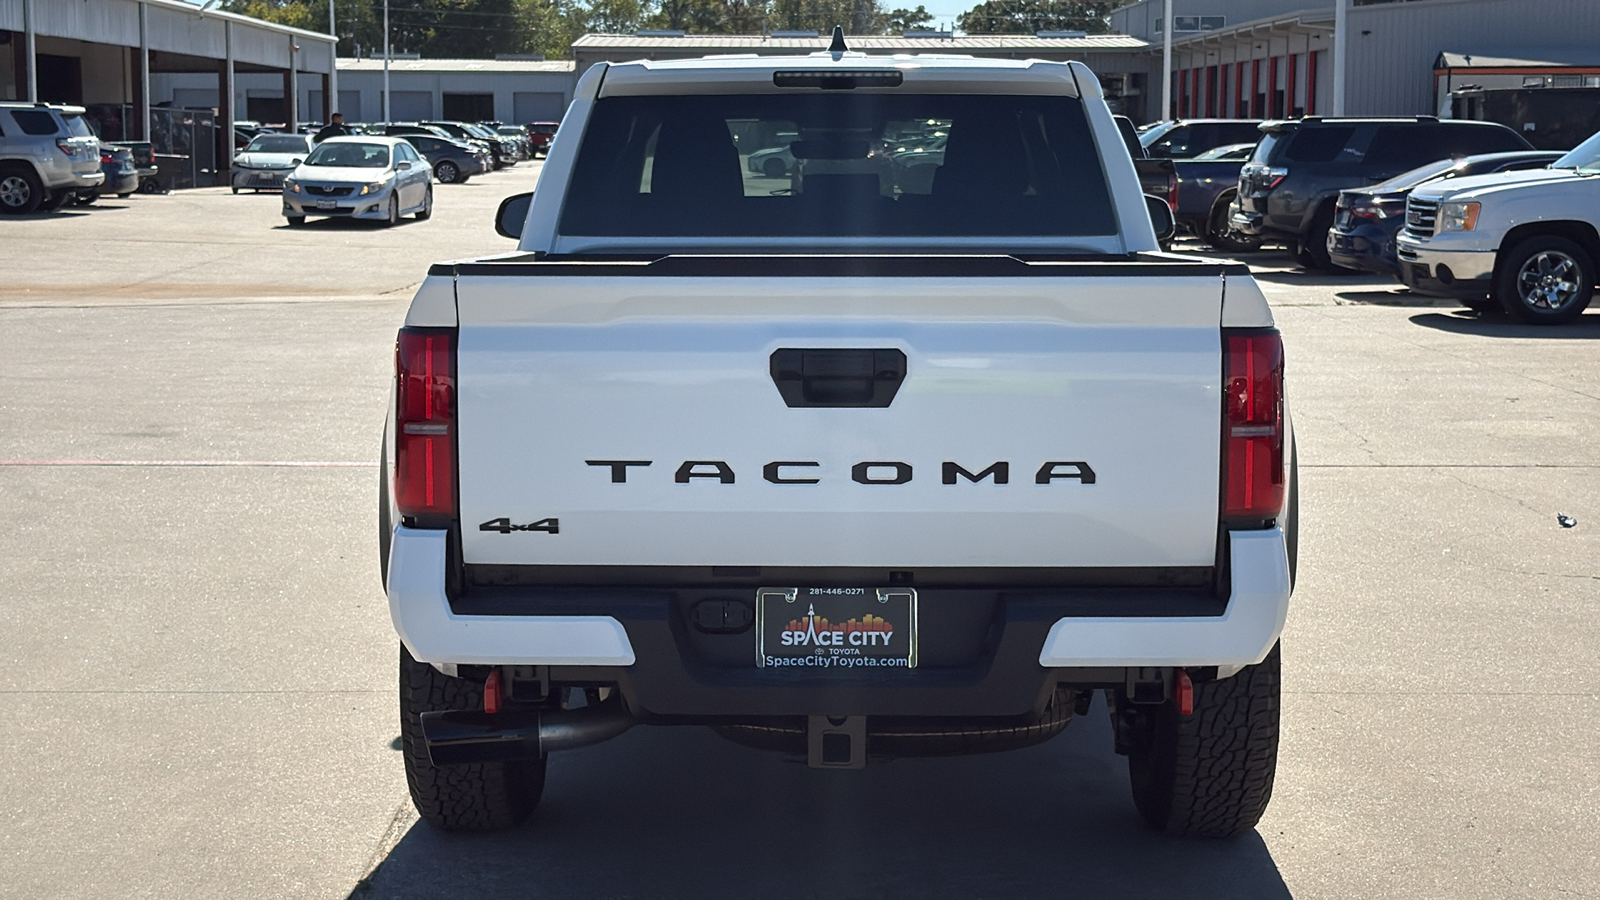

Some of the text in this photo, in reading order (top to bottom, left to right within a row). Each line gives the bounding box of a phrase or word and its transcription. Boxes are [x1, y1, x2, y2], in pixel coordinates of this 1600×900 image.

[584, 460, 1096, 485] TACOMA
[780, 630, 893, 646] SPACE CITY
[766, 655, 908, 668] SpaceCityToyota.com
